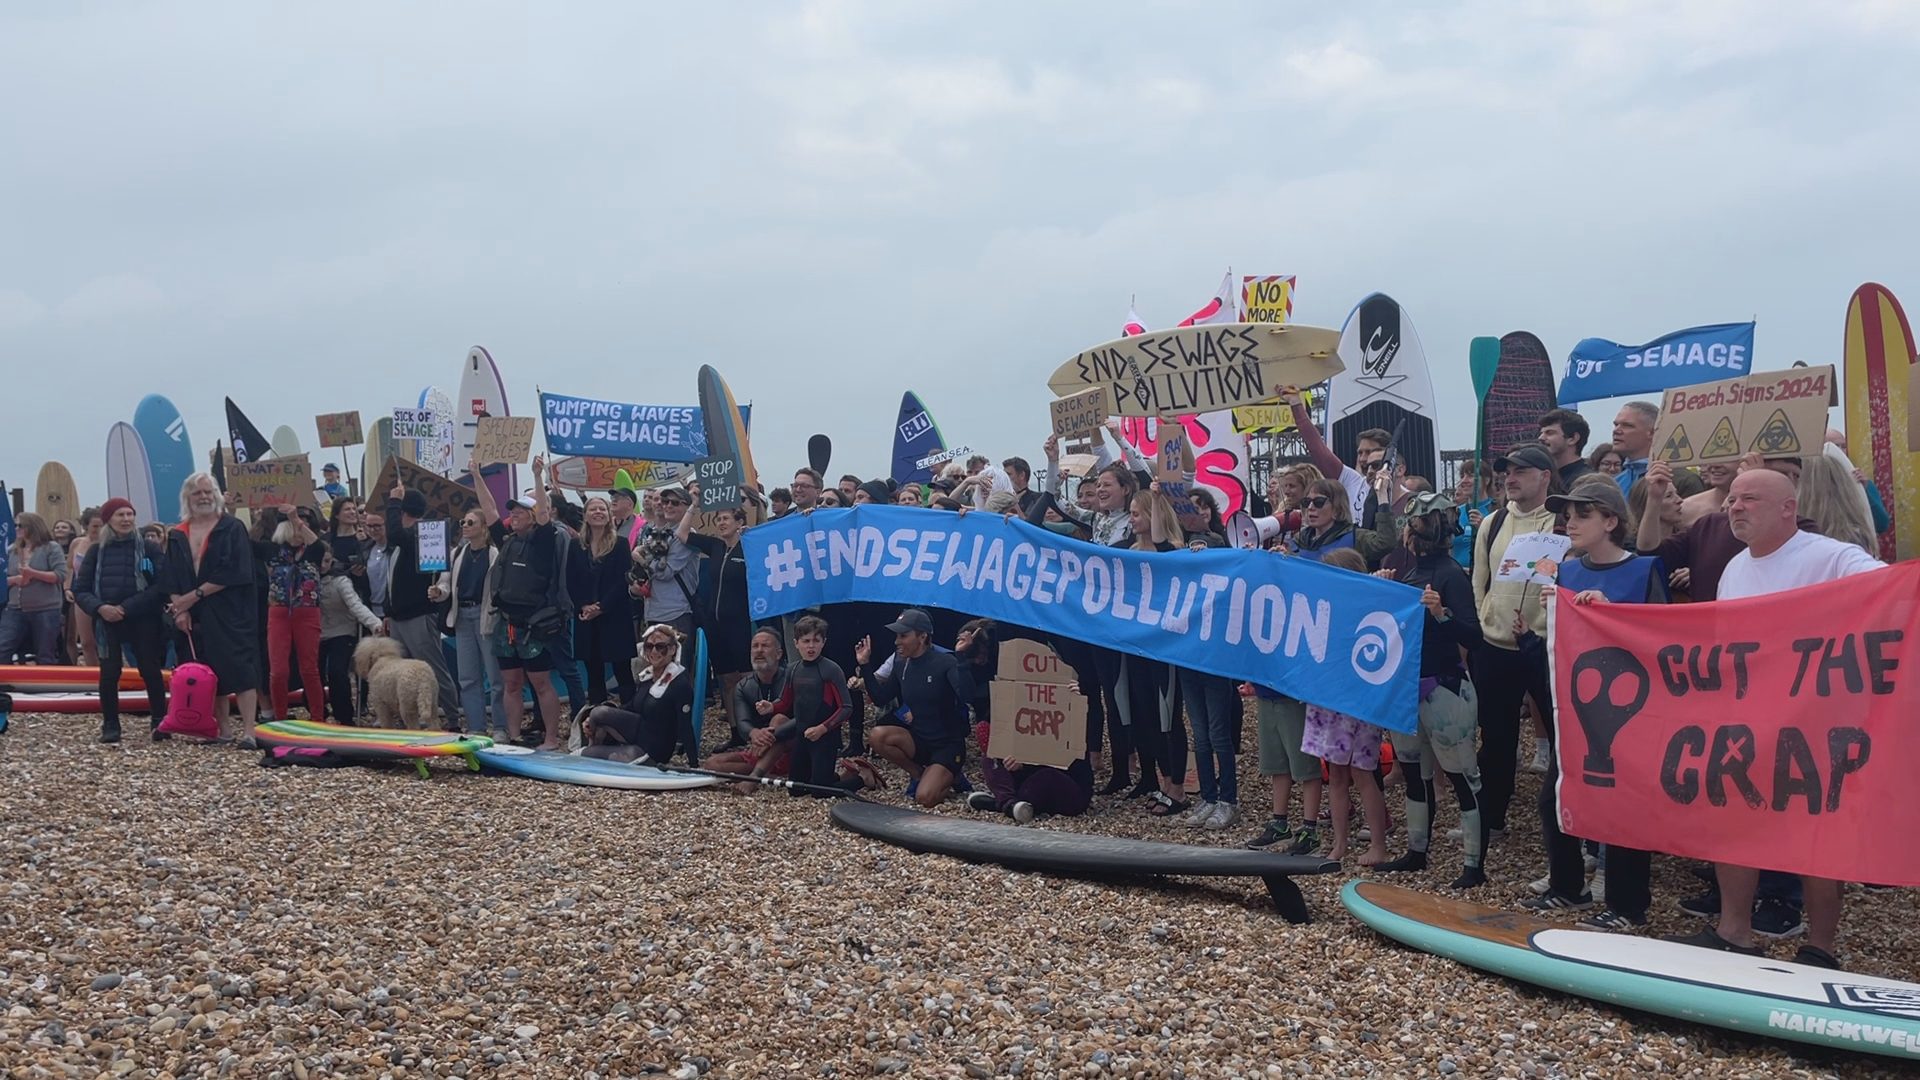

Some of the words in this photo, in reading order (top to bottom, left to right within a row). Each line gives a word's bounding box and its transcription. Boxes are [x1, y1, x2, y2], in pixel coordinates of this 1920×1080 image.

[1255, 282, 1281, 306] NO
[1247, 308, 1281, 323] MORE
[1077, 348, 1128, 383] END
[1138, 325, 1259, 374] SEWAGE
[1624, 343, 1746, 370] SEWAGE
[1056, 398, 1084, 413] SICK
[1088, 392, 1100, 405] OF
[1669, 386, 1724, 414] Beach
[1726, 383, 1775, 405] Signs
[1774, 374, 1827, 402] 2024
[394, 411, 414, 422] SICK
[417, 411, 431, 422] OF
[545, 399, 622, 420] PUMPING
[630, 407, 693, 424] WAVES
[1056, 408, 1101, 434] SEWAGE
[1242, 408, 1295, 427] SEWAG
[394, 423, 434, 437] SEWAGE
[482, 418, 529, 437] SPECIES
[545, 417, 586, 438] NOT
[592, 421, 681, 446] SEWAGE
[701, 460, 733, 478] STOP
[916, 454, 947, 469] CLEAN
[601, 467, 679, 486] SWAGE
[421, 521, 440, 530] STOP
[763, 526, 1332, 664] #ENDSEWAGEPOLLUTION
[1022, 653, 1059, 673] CUT
[1657, 642, 1761, 700] CUT
[1789, 629, 1904, 697] THE
[1025, 683, 1057, 705] THE
[1014, 707, 1065, 741] CRAP
[1660, 724, 1871, 815] CRAP
[1768, 1010, 1920, 1054] NAHSKWEL
